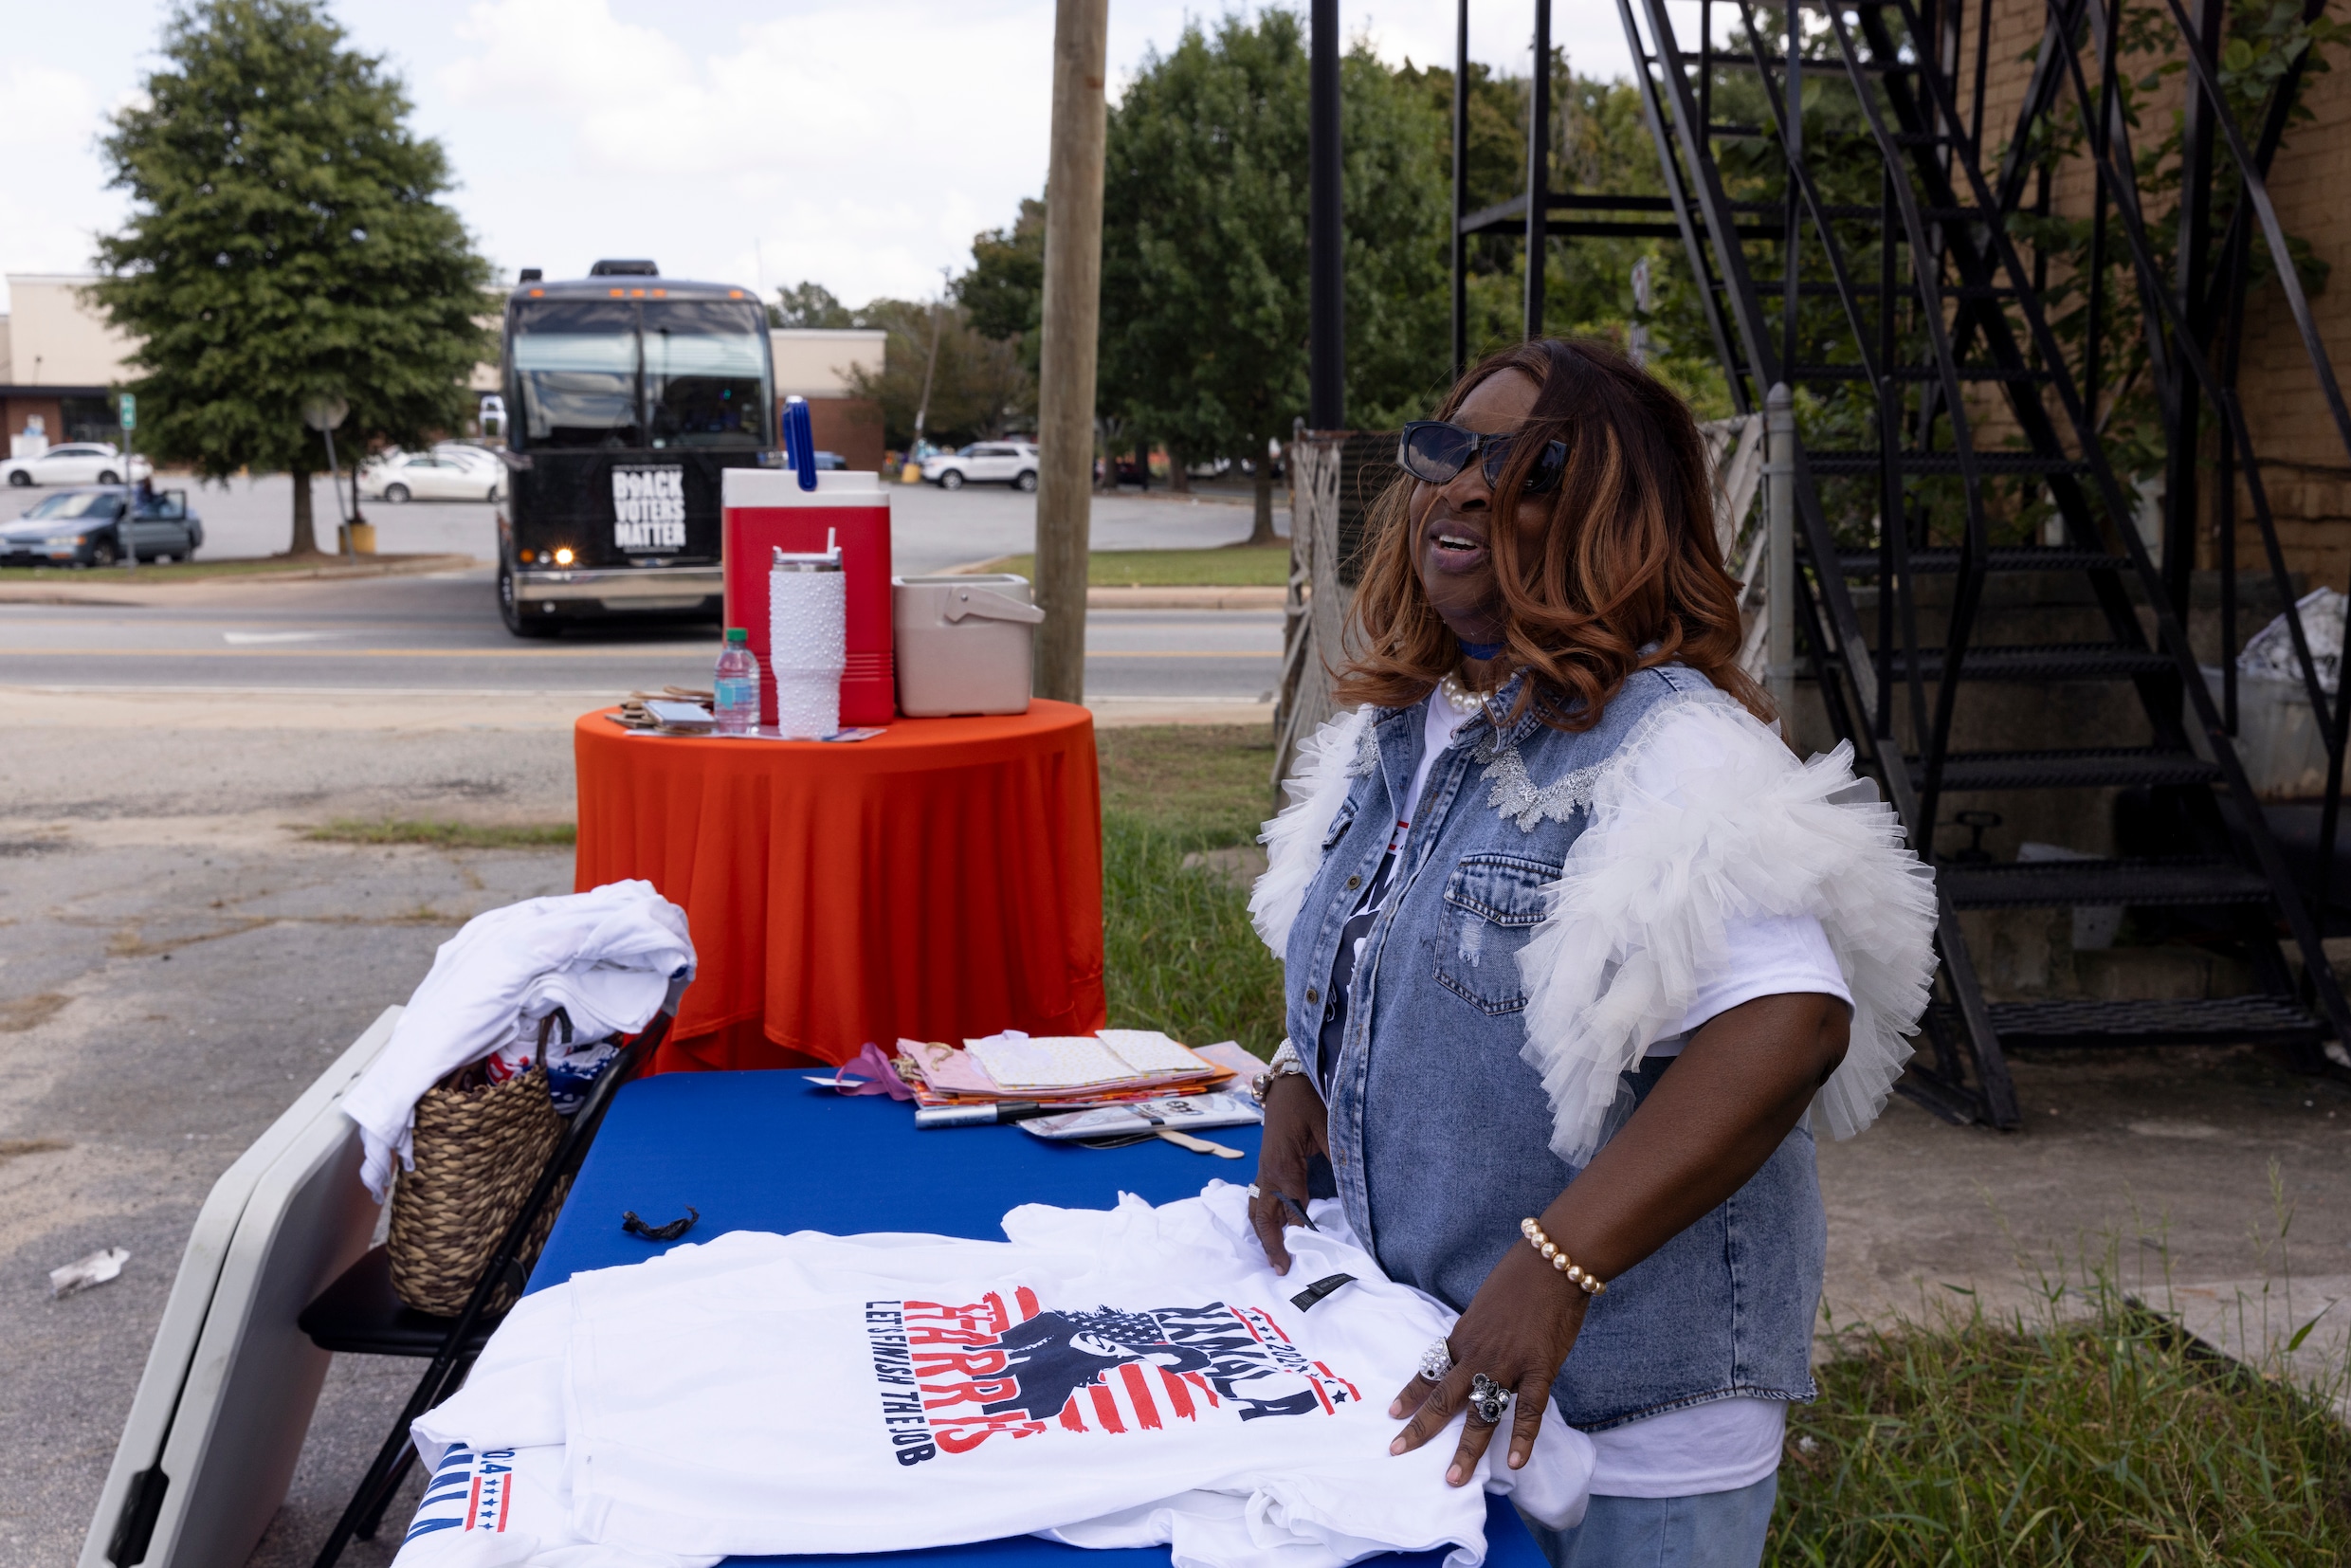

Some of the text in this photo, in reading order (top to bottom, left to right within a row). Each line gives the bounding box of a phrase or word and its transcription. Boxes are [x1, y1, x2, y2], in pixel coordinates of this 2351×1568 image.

[614, 499, 685, 521] VOTERS
[615, 521, 686, 548] MATTER
[866, 1300, 937, 1467] LET'S FINISH THE JOB
[903, 1301, 1034, 1454] HARRIS
[1148, 1302, 1319, 1422] KAMALA
[480, 1449, 515, 1474] 04
